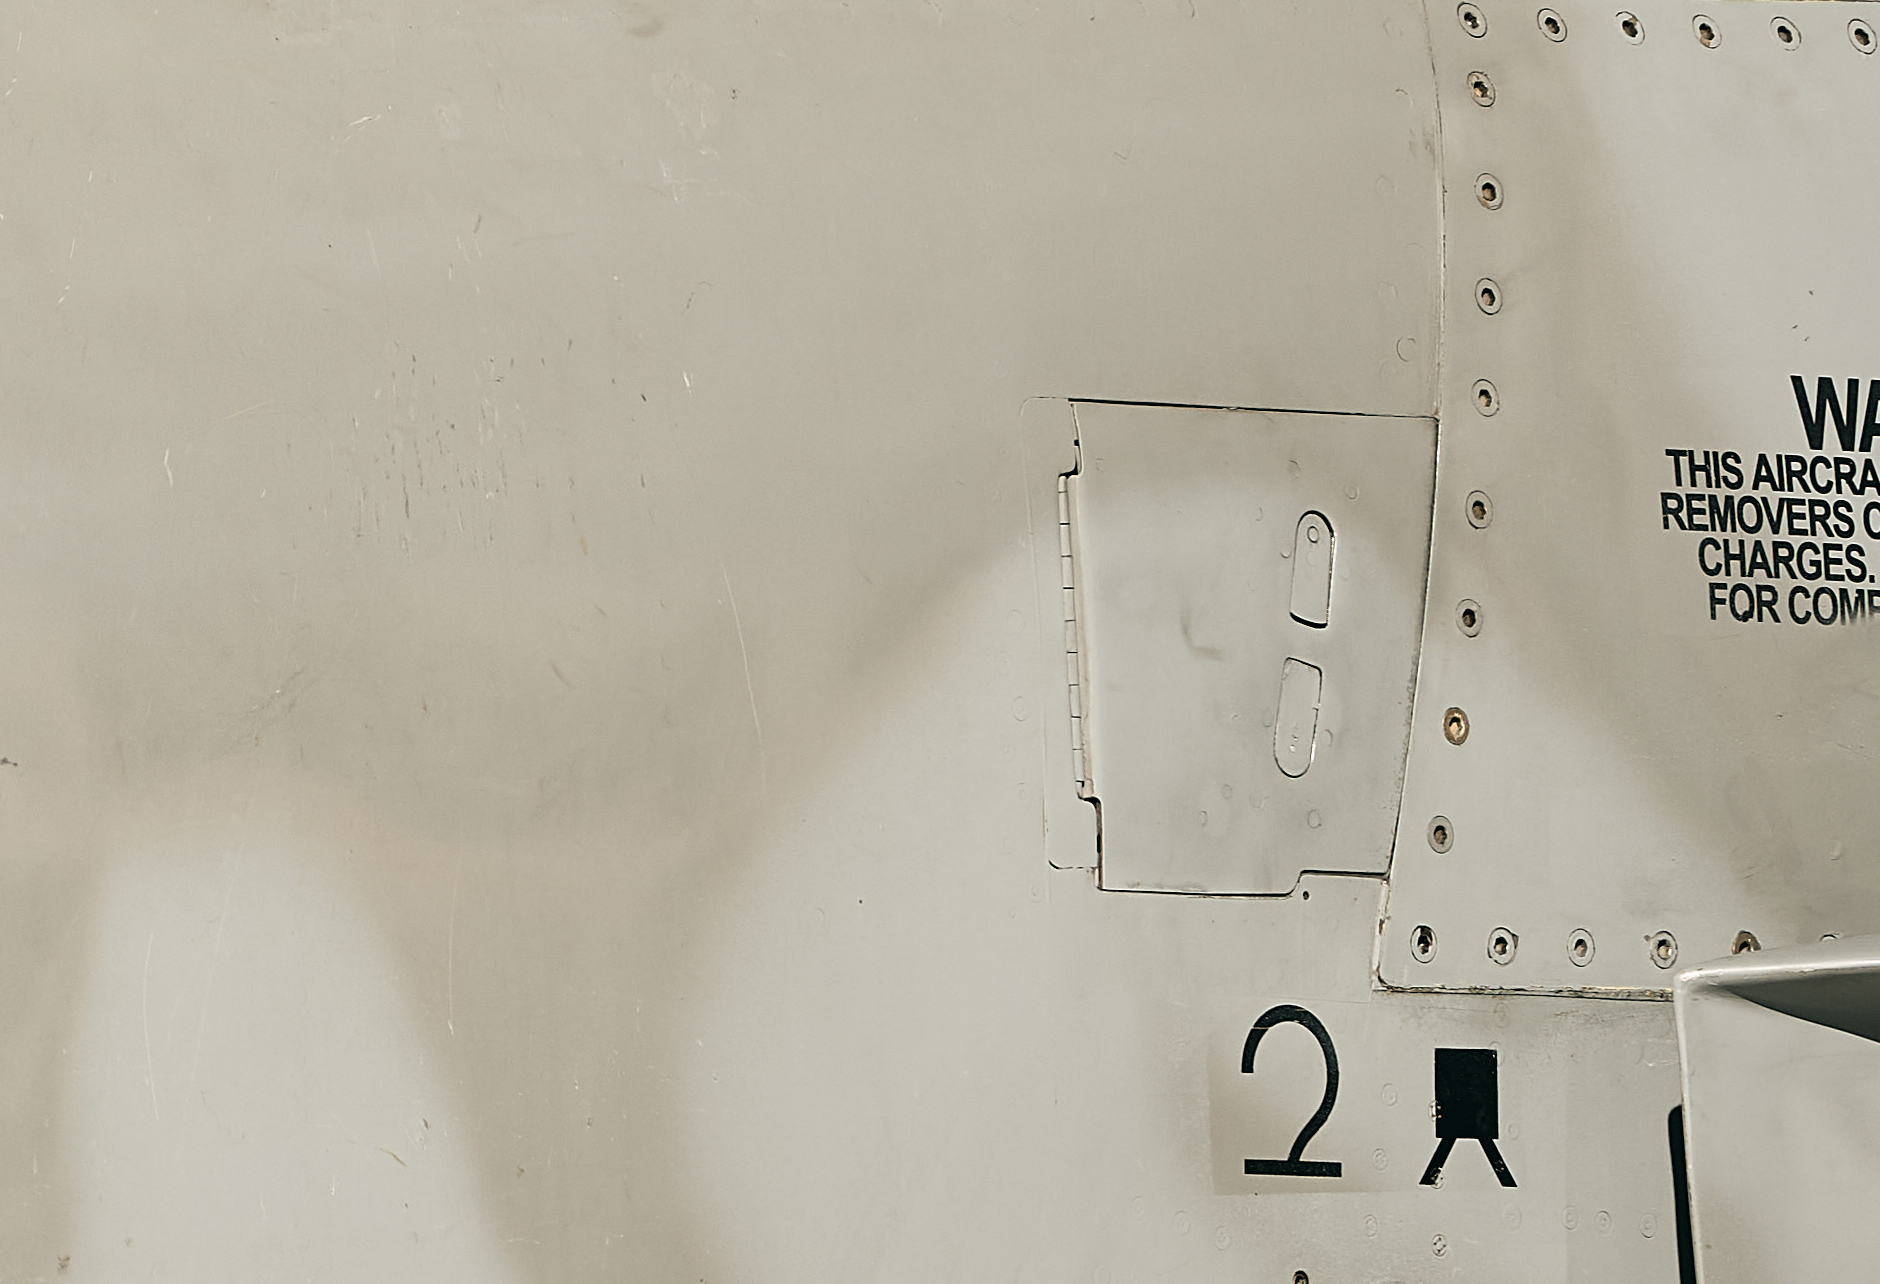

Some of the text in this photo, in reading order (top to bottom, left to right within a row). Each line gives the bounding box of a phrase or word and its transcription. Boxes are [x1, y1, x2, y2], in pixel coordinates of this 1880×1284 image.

[1664, 447, 1745, 490] THIS
[1662, 492, 1856, 540] REMOVERS
[1698, 538, 1876, 585] CHARGES.
[1708, 581, 1781, 624] FOR
[1241, 1004, 1342, 1177] 2
